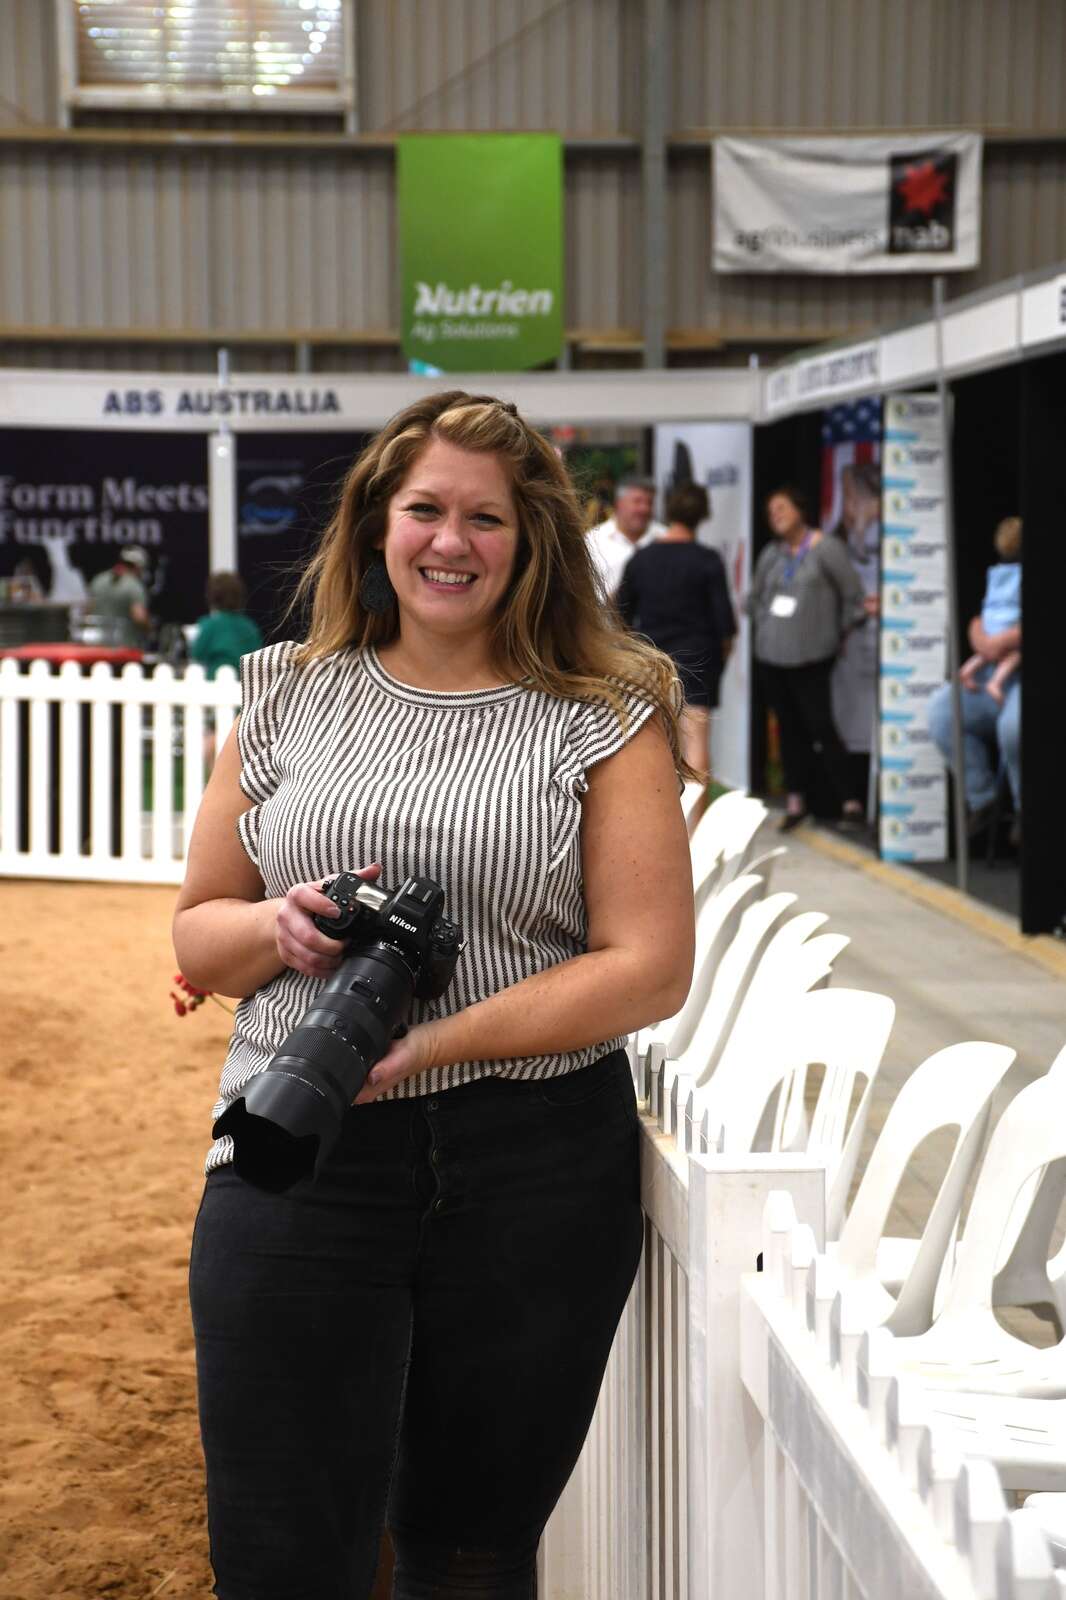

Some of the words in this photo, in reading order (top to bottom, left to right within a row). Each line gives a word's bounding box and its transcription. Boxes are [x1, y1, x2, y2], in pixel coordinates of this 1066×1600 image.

[415, 281, 553, 317] Nutrien
[104, 390, 163, 414] ABS
[177, 390, 340, 414] AUSTRALIA
[389, 914, 417, 933] Nikon
